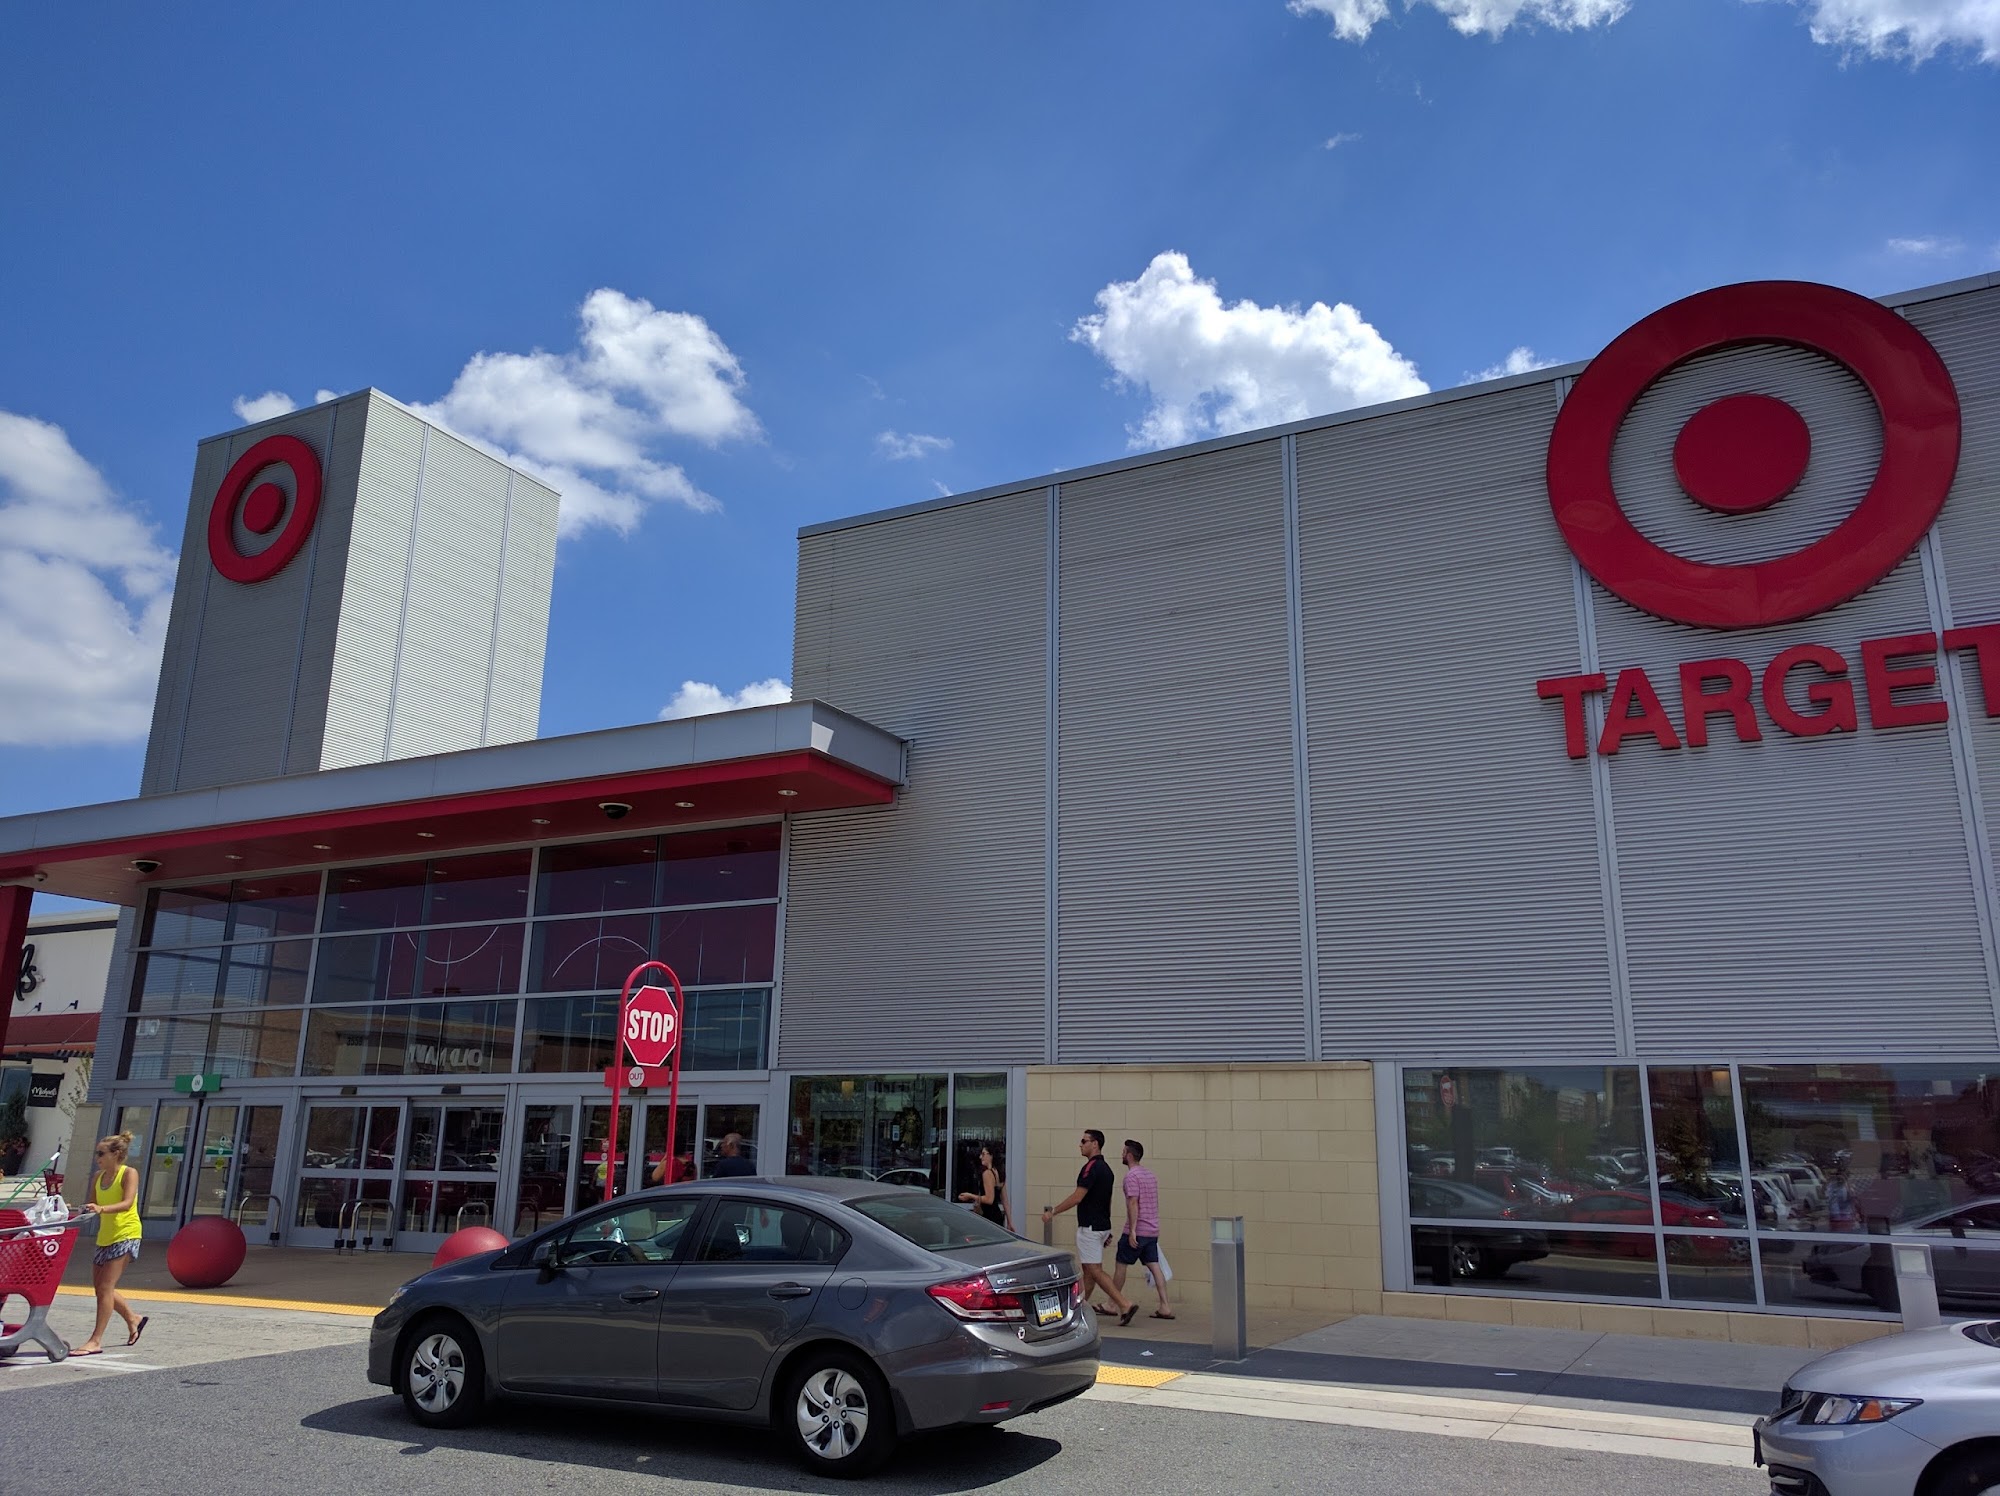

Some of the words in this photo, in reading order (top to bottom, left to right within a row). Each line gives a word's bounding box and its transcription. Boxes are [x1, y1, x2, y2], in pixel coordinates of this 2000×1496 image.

[1536, 623, 2000, 759] TARGET
[627, 1008, 675, 1043] STOP
[629, 1072, 643, 1081] OUT
